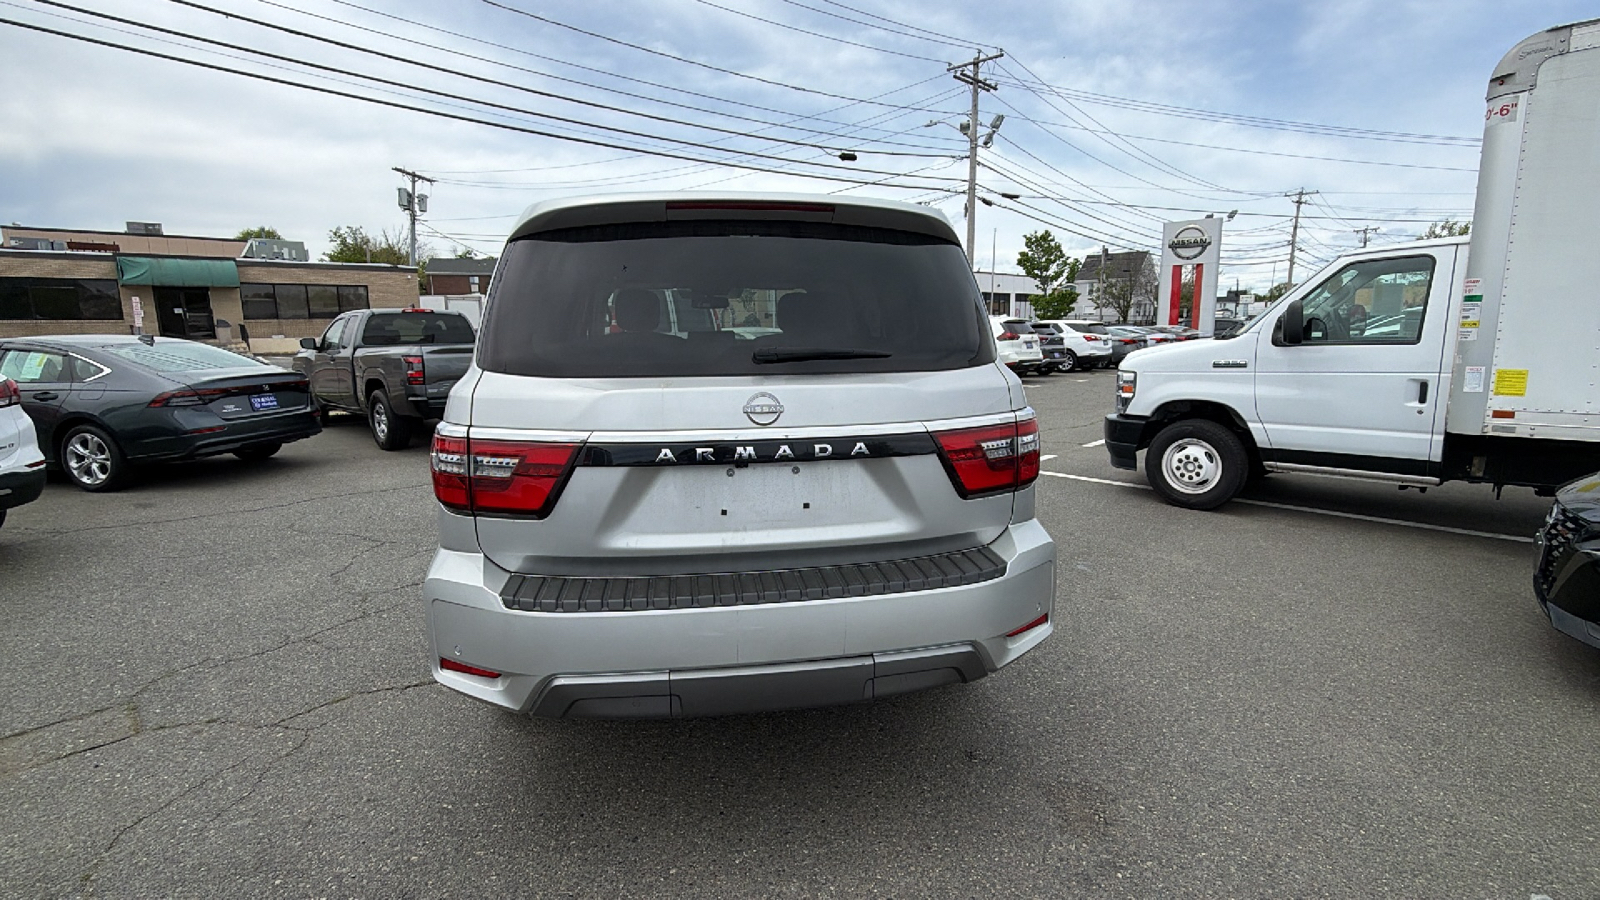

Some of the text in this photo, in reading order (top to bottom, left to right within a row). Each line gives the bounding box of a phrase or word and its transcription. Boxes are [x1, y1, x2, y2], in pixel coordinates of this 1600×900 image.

[1171, 237, 1208, 246] NISSAN
[743, 404, 784, 413] NISSAN
[656, 442, 870, 462] ARMADA
